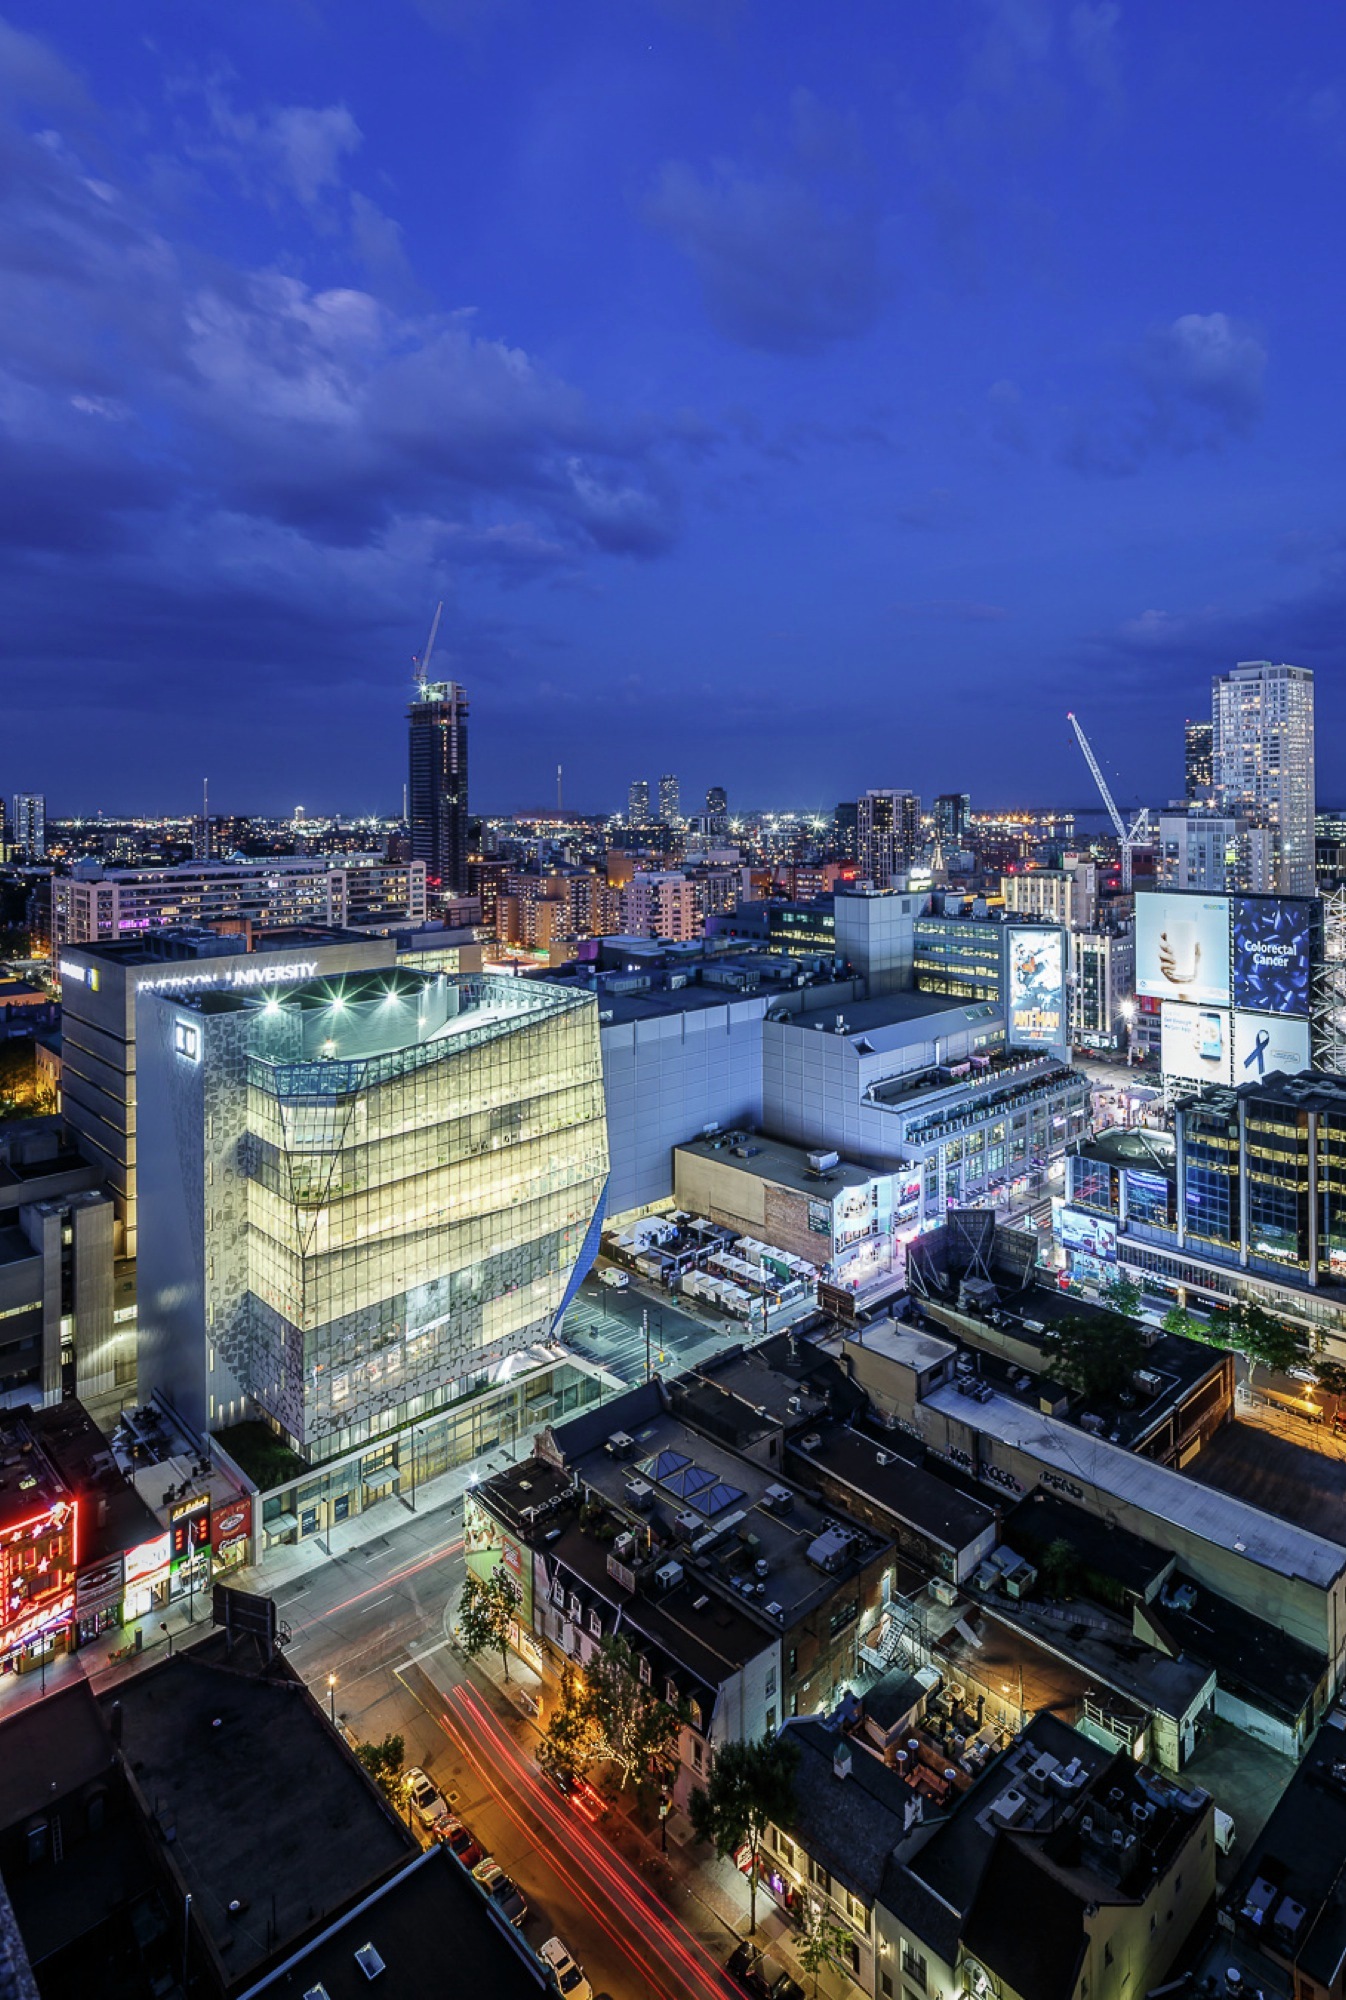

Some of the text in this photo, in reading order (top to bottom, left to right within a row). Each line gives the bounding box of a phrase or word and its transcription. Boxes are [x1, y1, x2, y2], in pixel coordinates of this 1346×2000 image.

[1244, 940, 1297, 956] Colorectal
[1252, 953, 1289, 967] Cancer
[225, 962, 318, 986] UNIVERSITY
